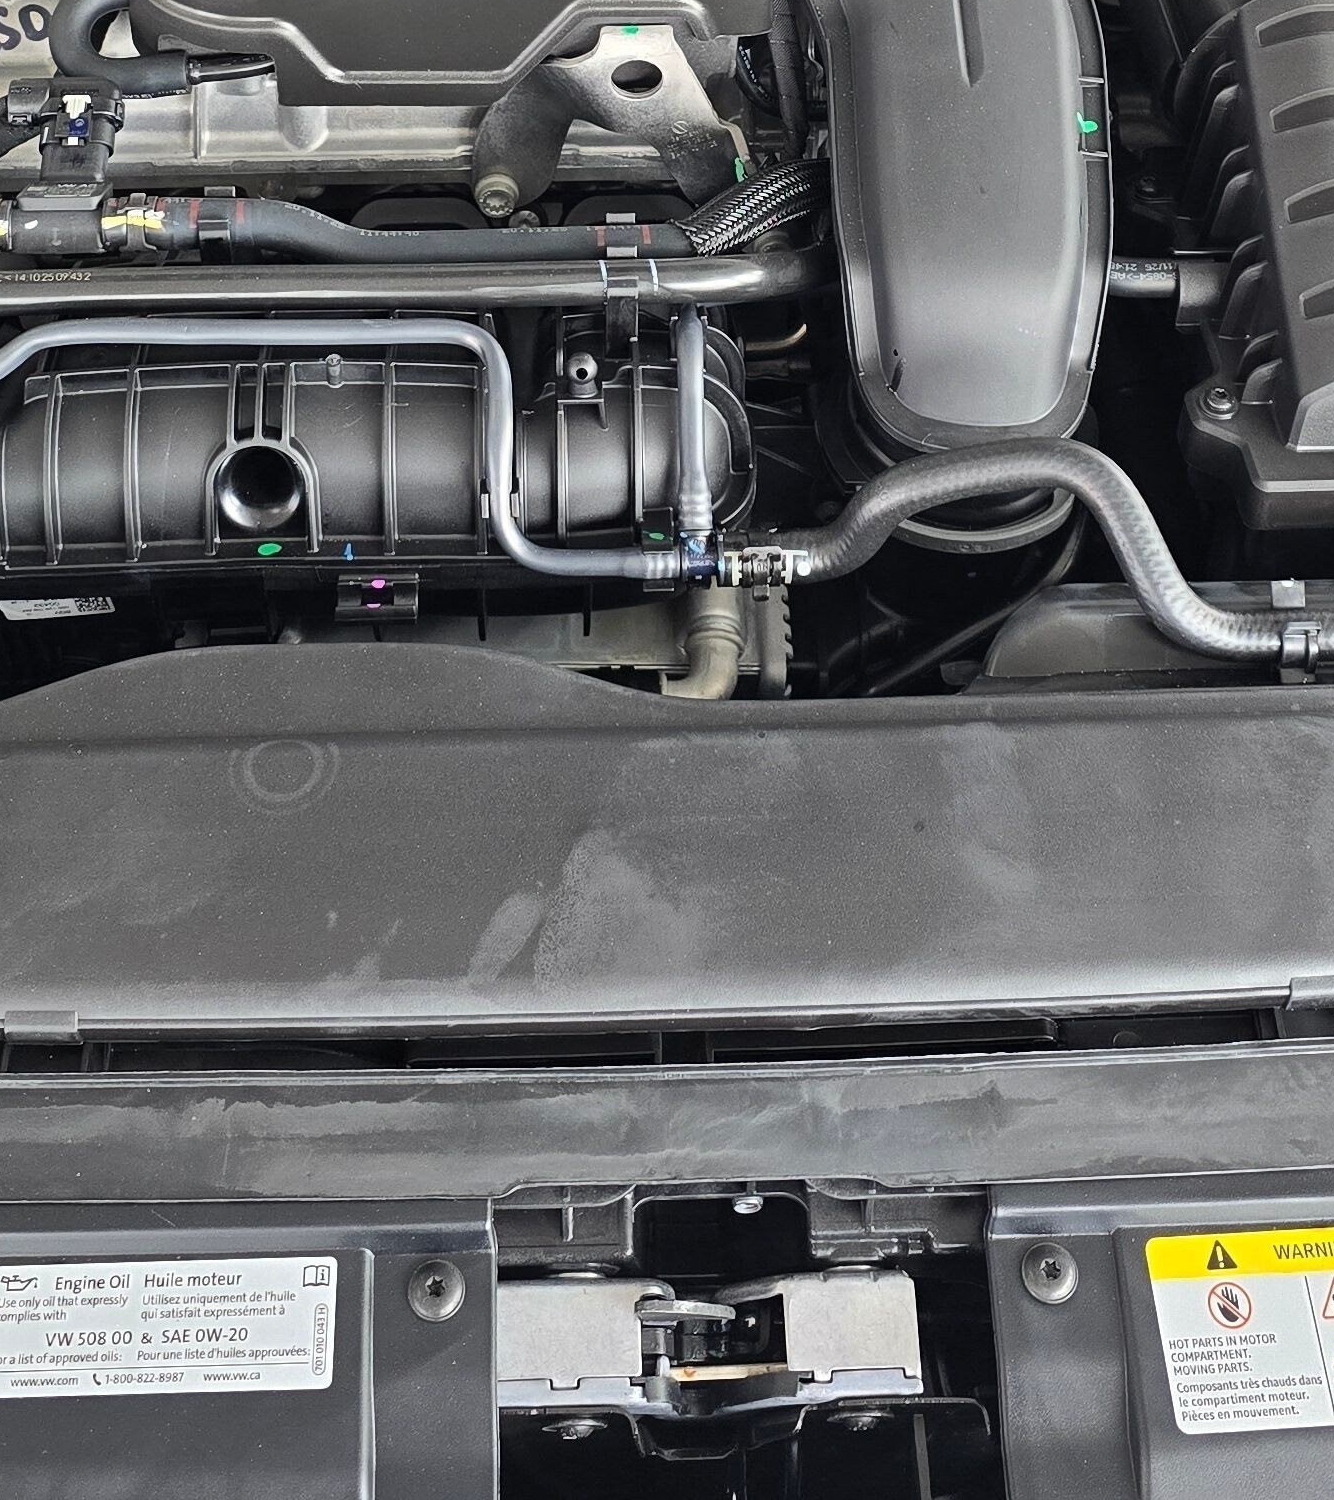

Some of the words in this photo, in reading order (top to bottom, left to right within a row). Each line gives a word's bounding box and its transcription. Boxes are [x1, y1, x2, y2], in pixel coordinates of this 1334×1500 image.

[55, 1275, 105, 1294] Engine
[109, 1274, 130, 1289] Oil
[144, 1272, 183, 1288] Huile
[187, 1272, 242, 1287] moteur
[18, 1296, 41, 1309] only
[42, 1295, 56, 1307] oil
[57, 1295, 78, 1307] that
[80, 1294, 128, 1308] expressly
[142, 1293, 181, 1306] Utilisez
[183, 1292, 247, 1306] uniquement
[249, 1291, 263, 1302] de
[264, 1290, 296, 1302] l'huile
[43, 1309, 67, 1321] with
[140, 1308, 158, 1320] qui
[160, 1306, 201, 1319] satisfait
[203, 1305, 277, 1319] expressément
[279, 1304, 285, 1316] à
[317, 1317, 325, 1334] 043
[46, 1332, 74, 1347] VW
[78, 1331, 107, 1346] 508
[111, 1330, 133, 1345] 00
[141, 1332, 153, 1344] &
[162, 1329, 190, 1344] SAE
[195, 1327, 248, 1343] 0W-20
[316, 1337, 324, 1353] 010
[1168, 1338, 1189, 1350] HOT
[1191, 1336, 1224, 1349] PARTS
[1225, 1335, 1237, 1346] IN
[1239, 1333, 1277, 1345] MOTOR
[9, 1356, 16, 1365] a
[18, 1353, 34, 1365] list
[36, 1352, 48, 1364] of
[49, 1351, 99, 1365] approved
[100, 1350, 122, 1362] oils:
[137, 1350, 161, 1361] Pour
[162, 1351, 183, 1360] une
[184, 1348, 206, 1360] liste
[207, 1347, 247, 1359] d'huiles
[248, 1345, 310, 1360] approuvées:
[1171, 1348, 1252, 1363] COMPARTMENT.
[315, 1356, 323, 1371] 701
[1173, 1363, 1216, 1376] MOVING
[1217, 1361, 1253, 1374] PARTS.
[10, 1377, 79, 1387] www.vw.com
[105, 1371, 185, 1385] 1-800-822-8987
[203, 1372, 261, 1382] www.vw.ca
[1176, 1380, 1239, 1394] Composants
[1240, 1377, 1260, 1390] très
[1261, 1375, 1297, 1388] chauds
[1298, 1374, 1323, 1386] dans
[1178, 1396, 1189, 1408] le
[1191, 1393, 1267, 1408] compartiment
[1268, 1391, 1310, 1402] moteur.
[1181, 1409, 1215, 1422] Pièces
[1217, 1410, 1231, 1420] en
[1232, 1405, 1300, 1419] mouvement.
